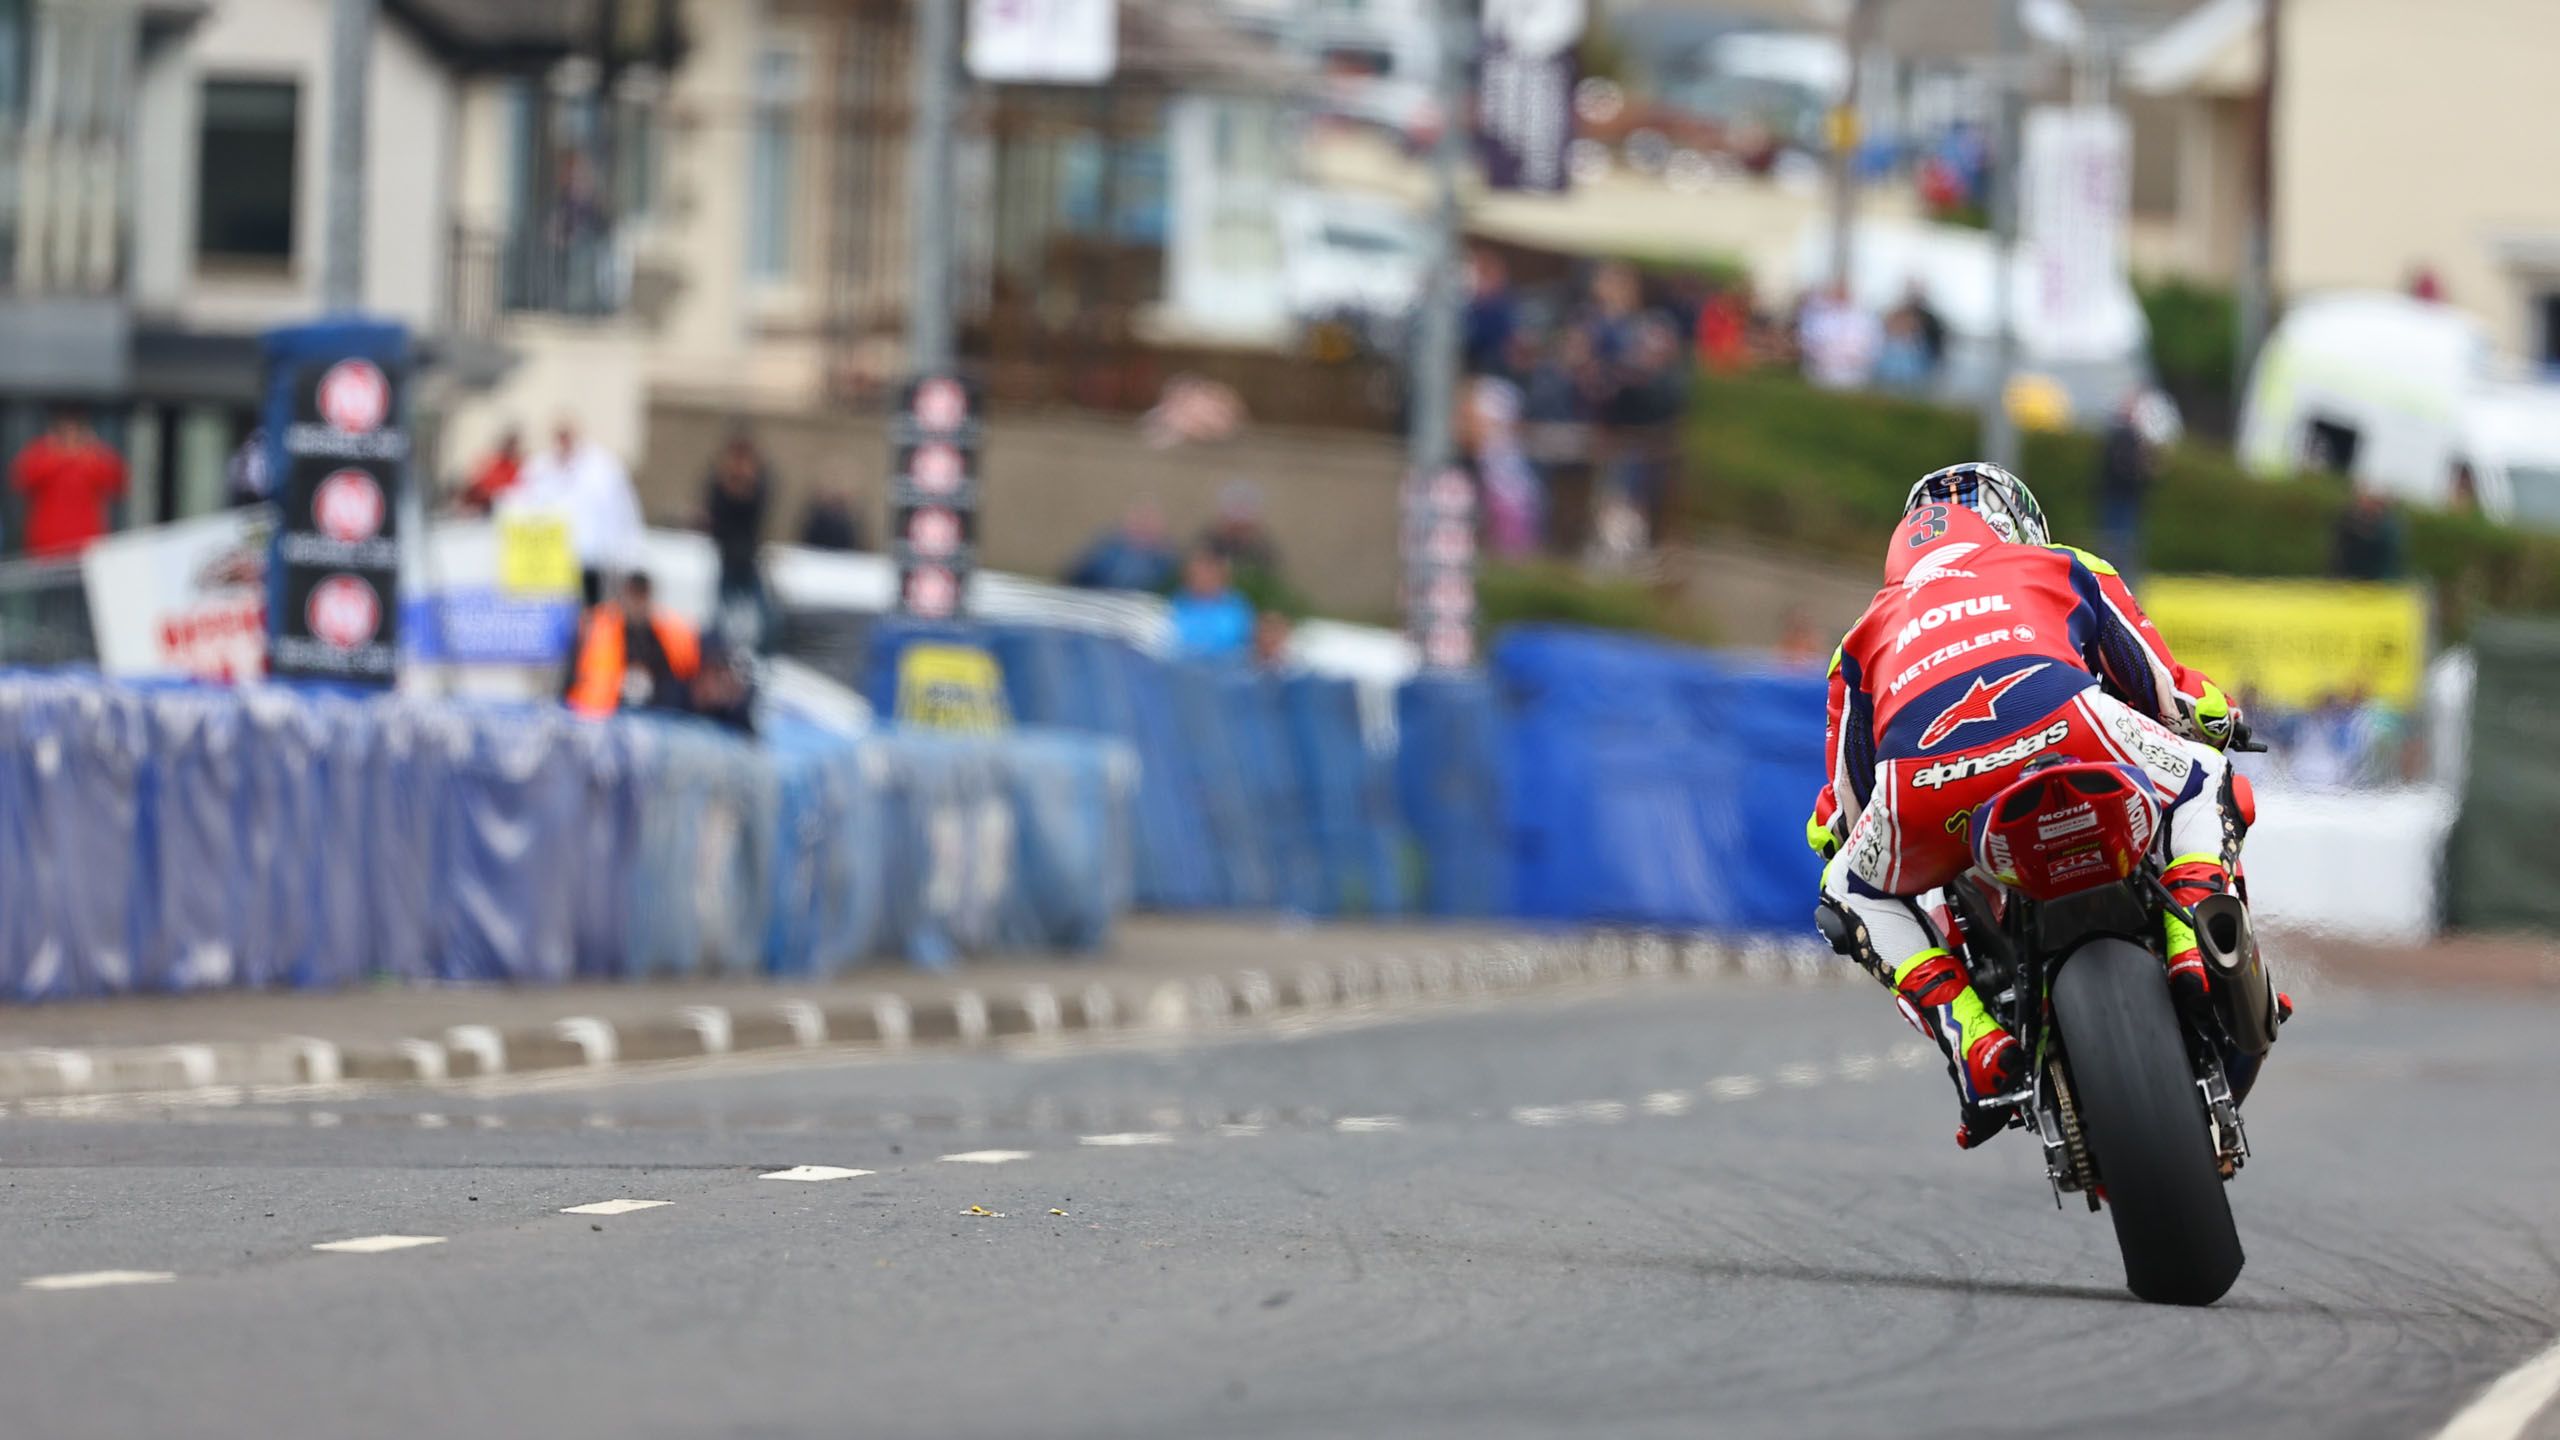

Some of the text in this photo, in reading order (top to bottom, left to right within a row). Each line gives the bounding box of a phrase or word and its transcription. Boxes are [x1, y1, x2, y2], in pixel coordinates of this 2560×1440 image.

[1907, 505, 1949, 548] 3
[1905, 566, 1979, 600] HONDA
[1896, 595, 2011, 654] MOTUL
[1888, 629, 2011, 696] METZELER
[1911, 719, 2070, 790] alpinestars
[2038, 801, 2092, 822] MOTUL
[2125, 790, 2150, 851] MOTUL
